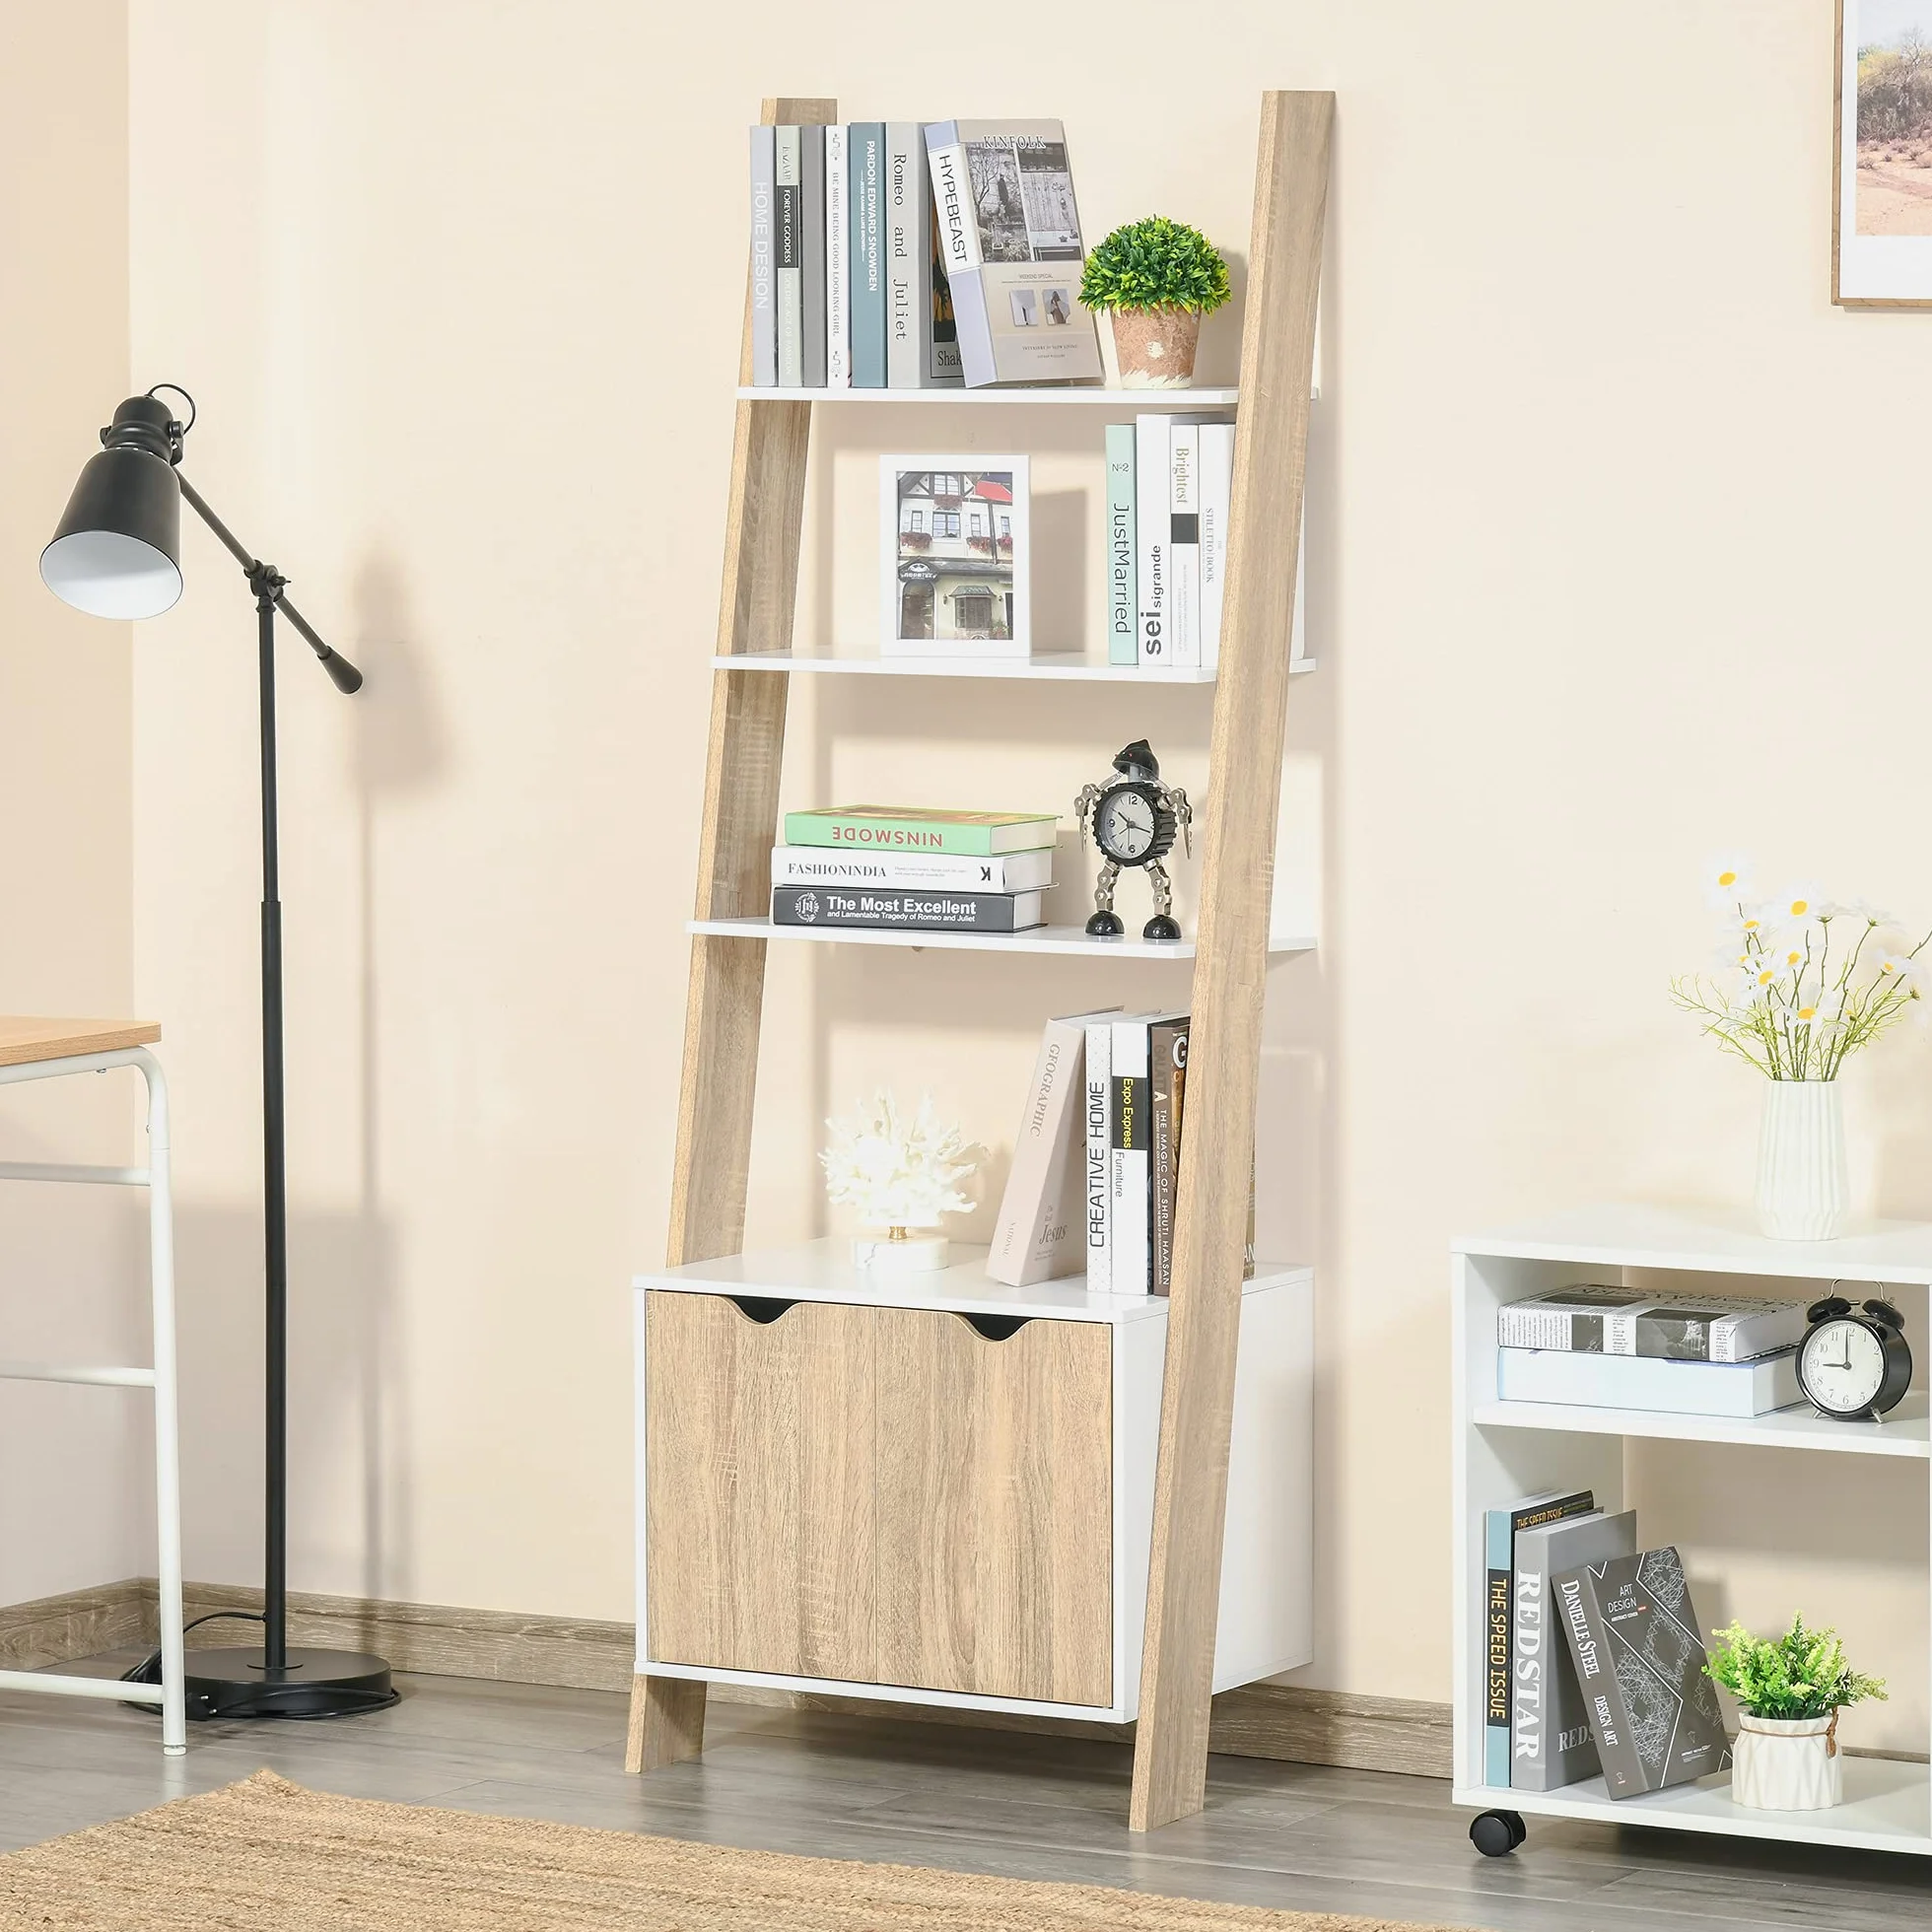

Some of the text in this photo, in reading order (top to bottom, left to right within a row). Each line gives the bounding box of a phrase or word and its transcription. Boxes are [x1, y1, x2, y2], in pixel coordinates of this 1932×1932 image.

[982, 134, 1048, 150] KINFOLK
[832, 172, 840, 184] BE
[754, 181, 770, 236] HOME
[783, 189, 793, 264] FOREVER GODDESS
[865, 140, 877, 292] PARDON EDWARD SNOWDEN
[938, 154, 968, 262] HYPEBEAST
[893, 153, 909, 340] Romeo and Juliet
[1173, 447, 1190, 505] Brightest
[1205, 507, 1215, 584] STILETTO BOOK
[1138, 544, 1165, 656] sei sigrande
[832, 826, 942, 848] NINSMODE
[788, 862, 887, 878] FASHIONINDIA
[826, 894, 977, 916] The Most Excellent
[826, 910, 976, 924] and Lamentable Tragedy of Romeo and Juliet
[1122, 1077, 1135, 1149] Expo Express
[1089, 1081, 1105, 1248] CREATIVE HOME
[1115, 1150, 1125, 1198] Furniture
[1159, 1109, 1171, 1285] THE MAGIC OF SHRUTI HAASAN
[1039, 1223, 1069, 1244] Jesus
[1608, 1596, 1637, 1614] DESIGN
[1620, 1583, 1633, 1597] ART
[1489, 1578, 1507, 1719] THE SPEED ISSUE
[1560, 1579, 1601, 1680] DANIELLE STEEL
[1594, 1694, 1620, 1748] DESIGN ART
